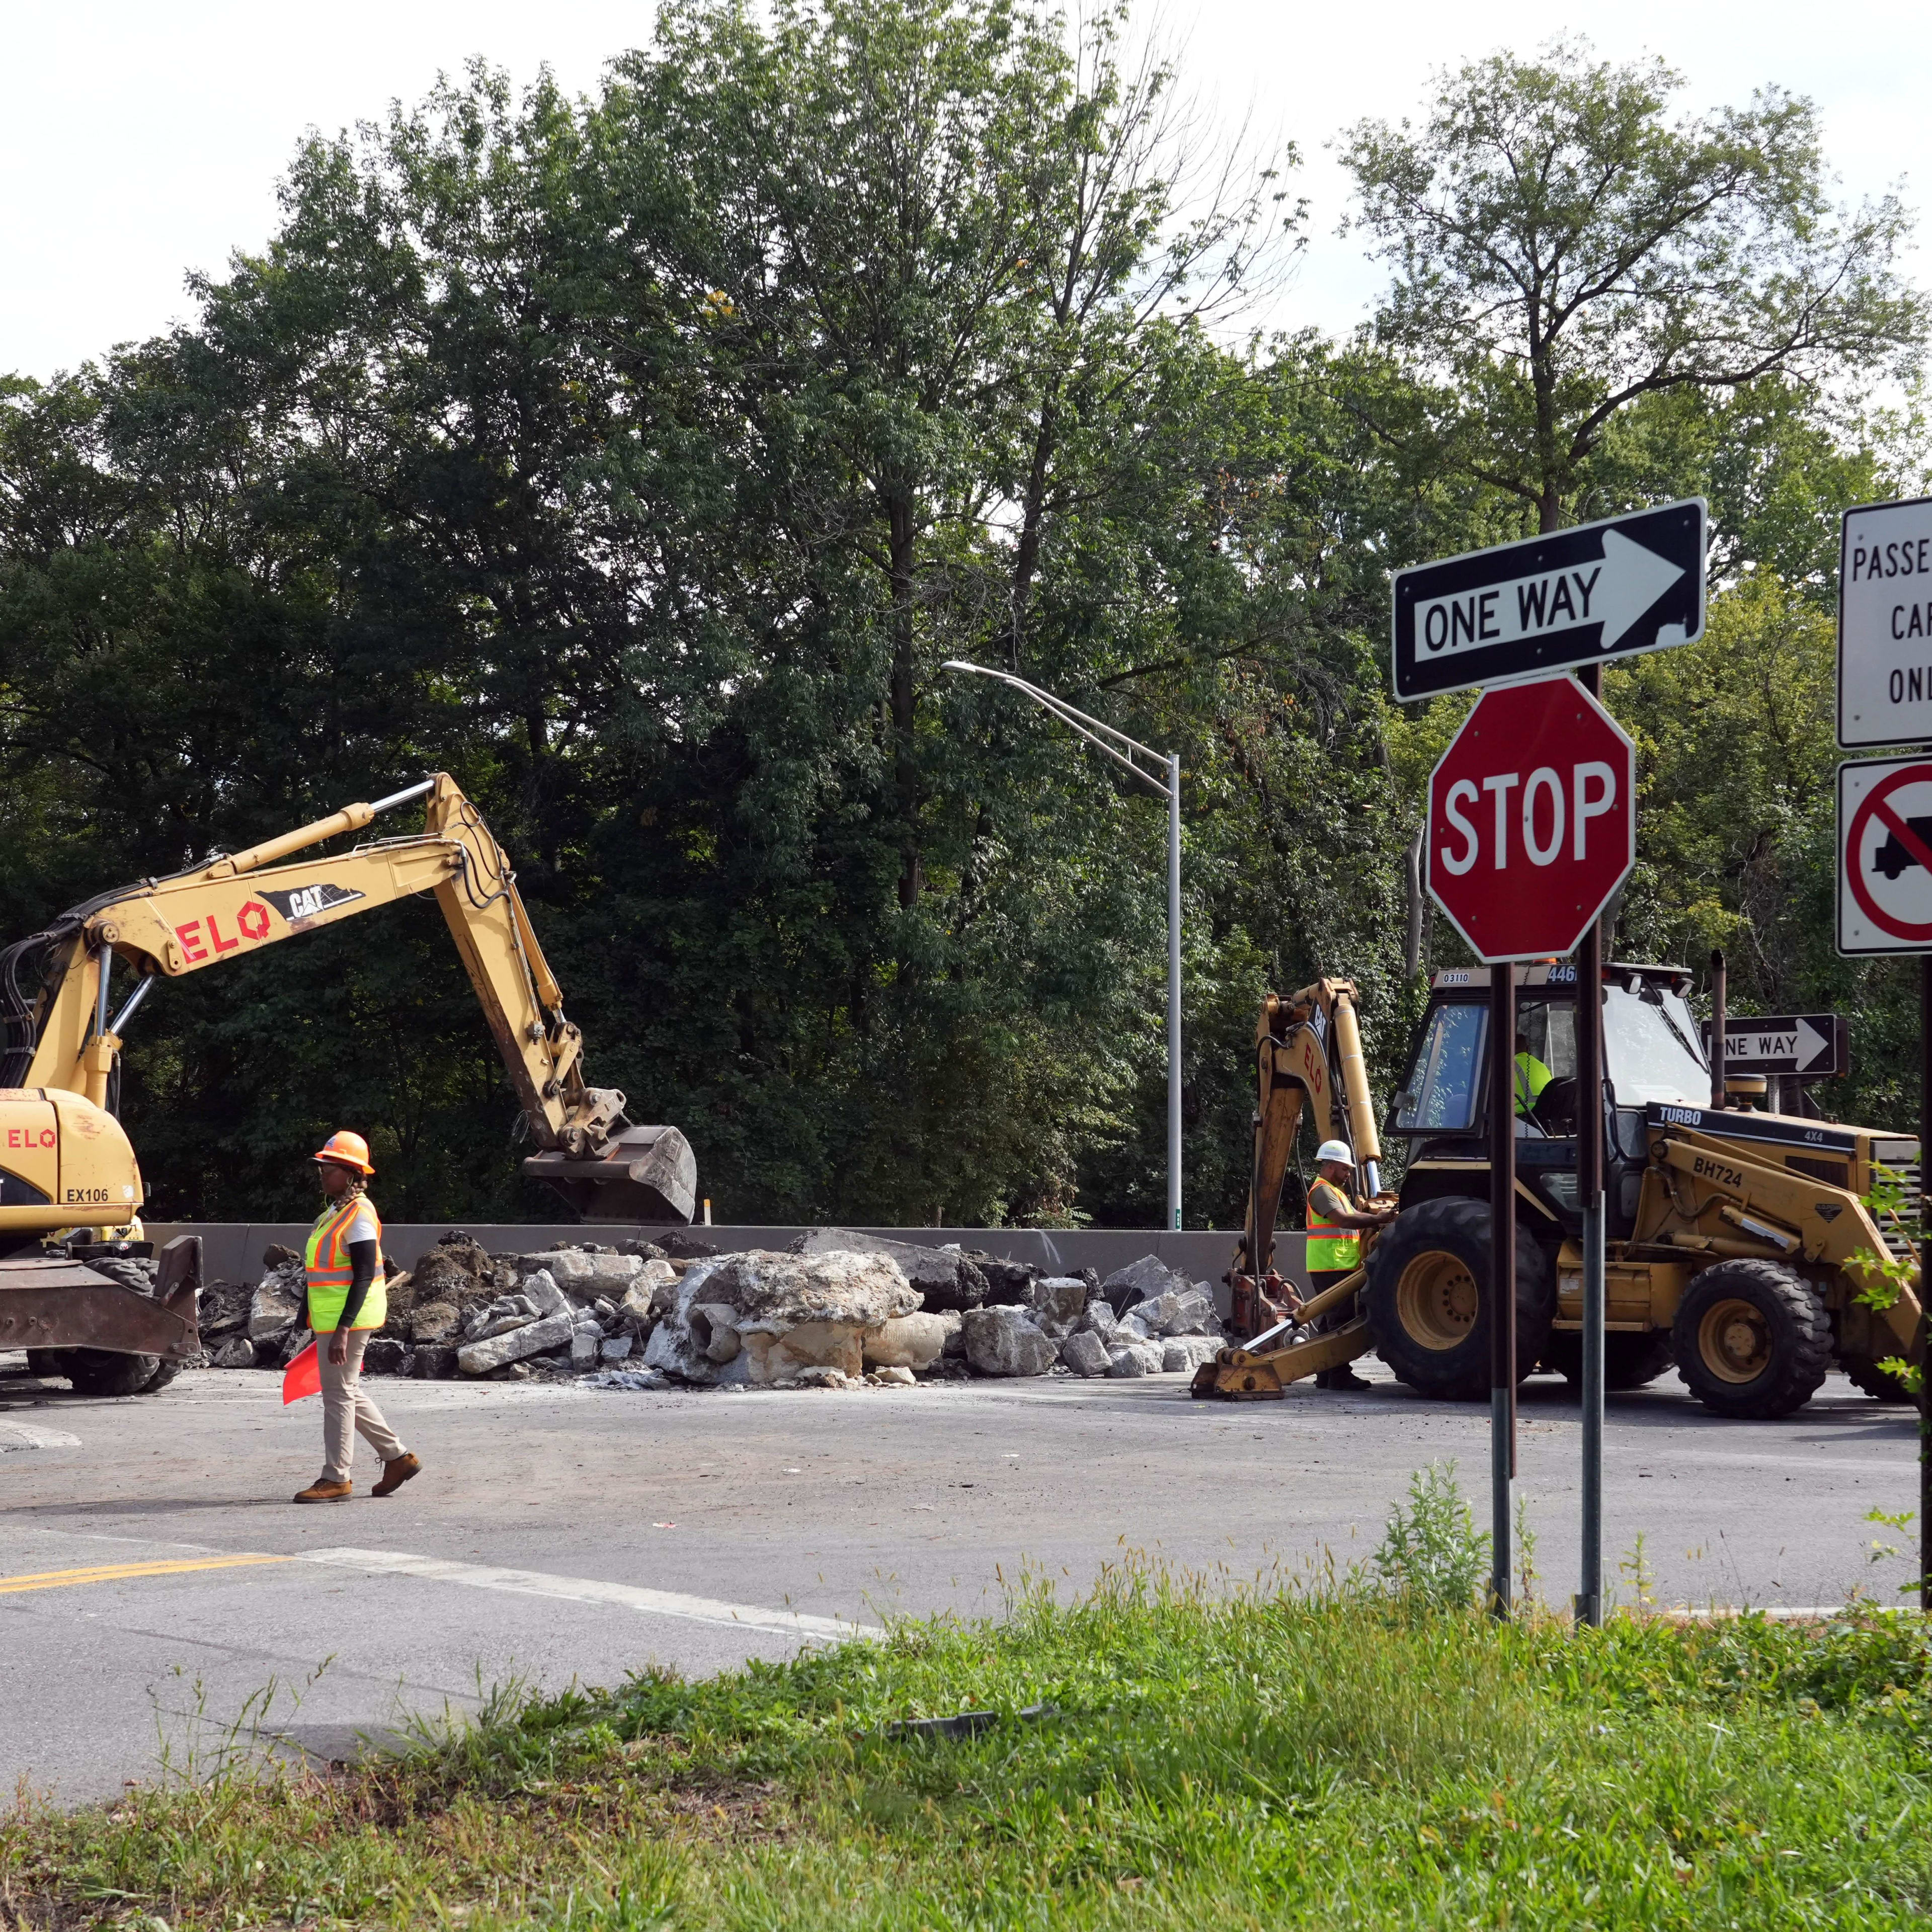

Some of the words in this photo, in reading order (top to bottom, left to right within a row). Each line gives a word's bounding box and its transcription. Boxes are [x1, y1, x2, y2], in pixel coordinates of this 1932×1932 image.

[1853, 538, 1930, 581] PASSE
[1425, 590, 1500, 652] ONE
[1517, 567, 1601, 631] WAY
[1441, 761, 1616, 875] STOP
[289, 886, 324, 917] CAT
[1444, 974, 1468, 982] 03110
[1548, 965, 1577, 982] 446
[1315, 1004, 1326, 1040] CAT
[1725, 1038, 1747, 1055] NE
[1759, 1036, 1797, 1054] WAY
[1660, 1107, 1702, 1125] TURBO
[1804, 1131, 1823, 1142] 4X4
[1693, 1157, 1742, 1188] BH724
[67, 1189, 108, 1202] EX106
